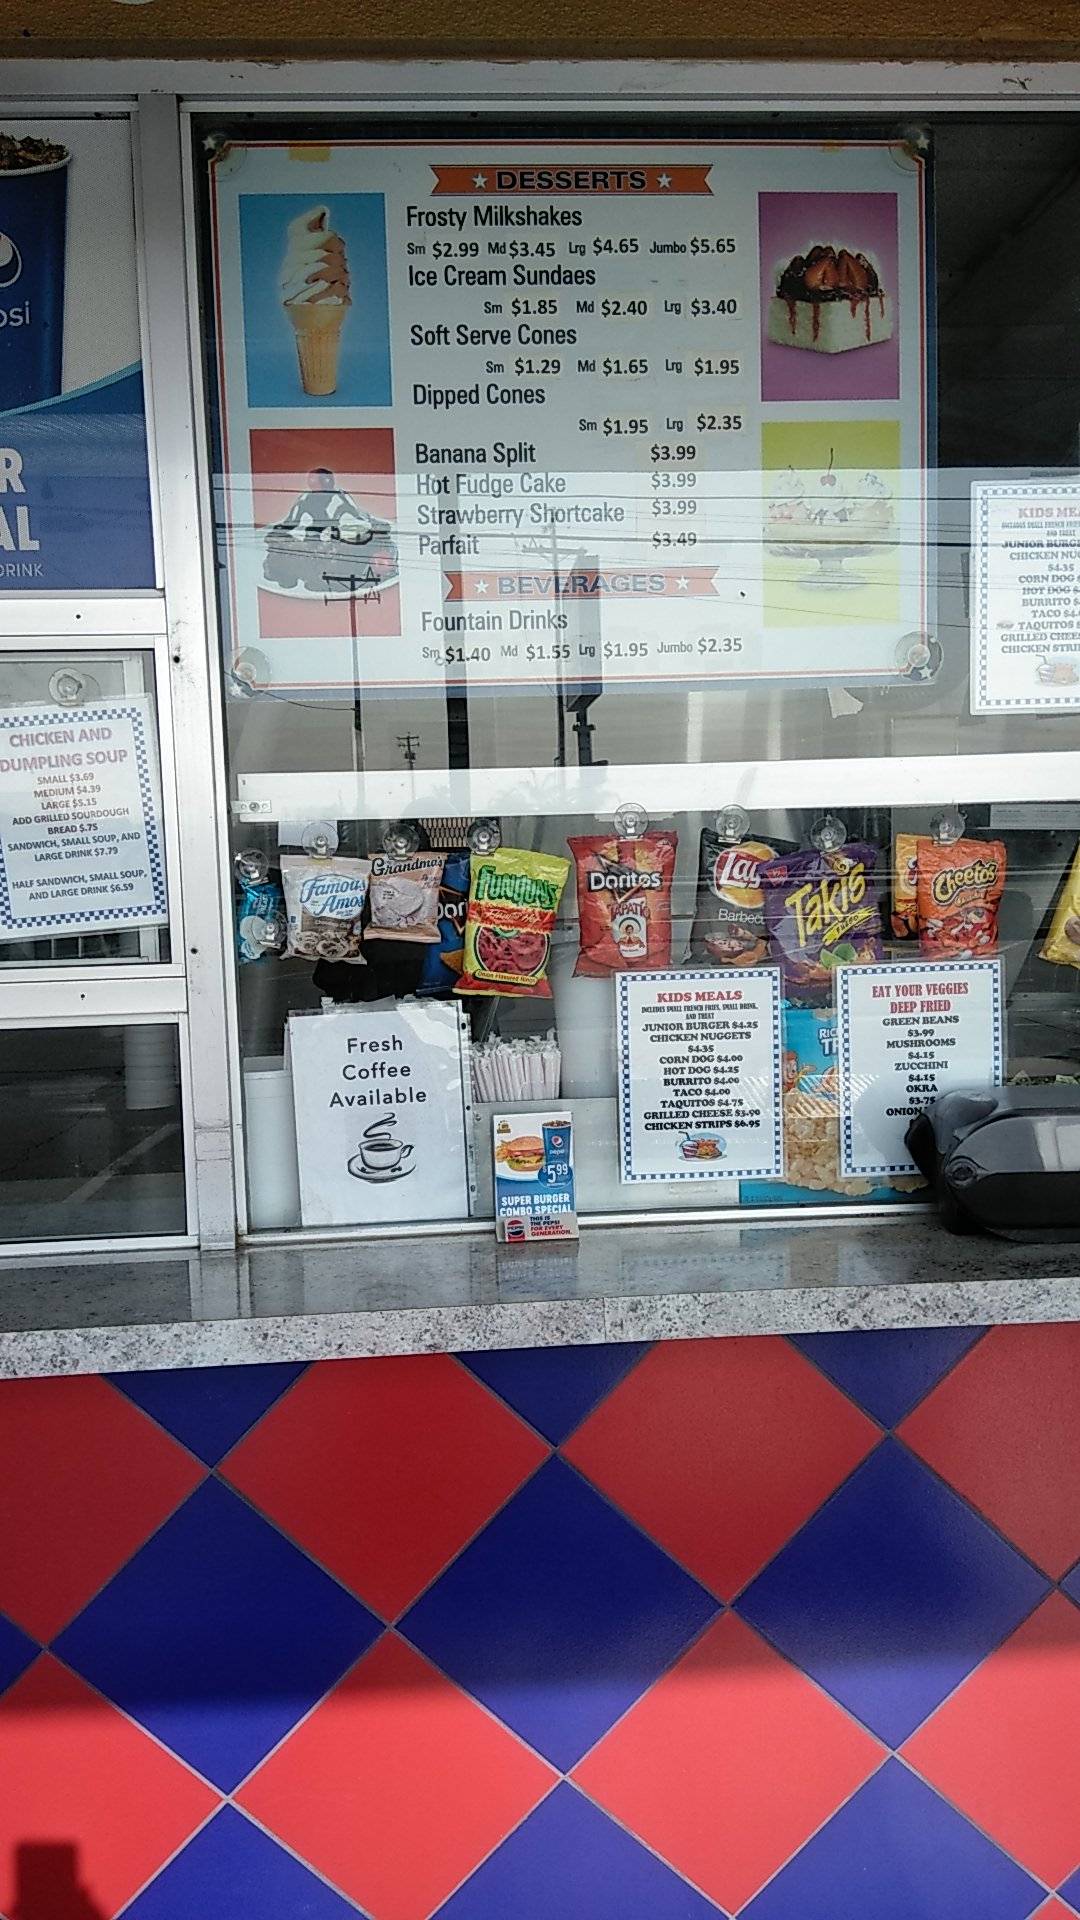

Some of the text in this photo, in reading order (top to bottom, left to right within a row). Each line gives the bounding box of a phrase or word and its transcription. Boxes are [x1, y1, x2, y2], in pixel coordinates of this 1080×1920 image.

[498, 171, 645, 189] DESSERTS
[407, 205, 582, 231] Frosty Milkshakes
[407, 238, 736, 259] Sm $2.99 Md $3.45 Lrg $4.65 Jumbo $5.65
[408, 264, 596, 286] Ice Cream Sundaes
[484, 298, 737, 317] Sm $1.85 Md $2.40 Lrg $3.40
[411, 324, 577, 345] Soft Serve Cones
[486, 358, 740, 376] Sm $1.29 Md $1.65 Lrg $1.95
[413, 384, 545, 409] Dipped Cones
[579, 415, 742, 435] Sm $1.95 Lrg $2.35
[415, 442, 696, 467] Banana Split $3.99
[417, 472, 697, 498] Hot Fudge Cake $3.99
[417, 499, 697, 528] Strawberry Shortcake $3.99
[1019, 508, 1053, 518] KIDS
[419, 531, 697, 556] Parfait $3.49
[499, 574, 665, 595] BEVERAGES
[421, 610, 568, 632] Fountain Drinks
[1031, 610, 1061, 618] TACO
[422, 638, 742, 664] Sm $1.40 Md $1.55 Lrg $1.95 Jumbo $2.35
[10, 727, 112, 747] CHICKEN AND
[0, 749, 128, 772] DUMPLING SOUP
[37, 772, 94, 785] SMALL $3.69
[34, 784, 101, 798] MEDIUM $4.39
[41, 798, 97, 810] LARGE $5.15
[12, 808, 129, 825] ADD GRILLED SOURDOUGH
[48, 823, 98, 834] BREAD $.75
[8, 832, 140, 851] SANDWICH, SMALL SOUP, AND
[34, 846, 118, 861] LARGE DRINK $7.79
[371, 857, 442, 876] Grandma's
[720, 852, 761, 888] Lay
[12, 869, 147, 889] HALF SANDWICH, SMALL SOUP,
[590, 872, 661, 890] Doritos
[935, 862, 996, 901] Cheetos
[29, 883, 134, 900] AND LARGE DRINK $6.59
[301, 880, 366, 903] Famous
[313, 895, 364, 915] Amos
[785, 863, 865, 947] Takis
[657, 990, 742, 1002] KIDS MEALS
[872, 982, 969, 998] EAT YOUR VEGGIES
[890, 999, 951, 1013] DEEP FRIED
[642, 1021, 758, 1031] JUNIOR BURGER $4.25
[882, 1015, 959, 1026] GREEN BEANS
[347, 1035, 403, 1053] Fresh
[650, 1031, 751, 1042] CHICKEN NUGGETS
[886, 1038, 956, 1048] MUSHROOMS
[688, 1045, 714, 1053] $4.35
[659, 1054, 743, 1064] CORN DOG $4.00
[895, 1061, 948, 1070] ZUCCHINI
[342, 1062, 411, 1080] Coffee
[664, 1067, 686, 1075] HOT
[688, 1066, 711, 1074] DOG
[909, 1074, 935, 1082] $4.15
[663, 1077, 740, 1086] BURRITO $4.00
[906, 1084, 938, 1093] OKRA
[329, 1086, 427, 1108] Available
[673, 1088, 730, 1097] TACO $4.00
[660, 1098, 743, 1109] TAQUITOS $4.75
[644, 1111, 689, 1120] GRILLED
[692, 1109, 733, 1118] CHEESE
[644, 1120, 760, 1130] CHICKEN STRIPS $6.95
[502, 1193, 570, 1206] SUPER BURGER
[500, 1204, 572, 1216] COMBO SPECIAL
